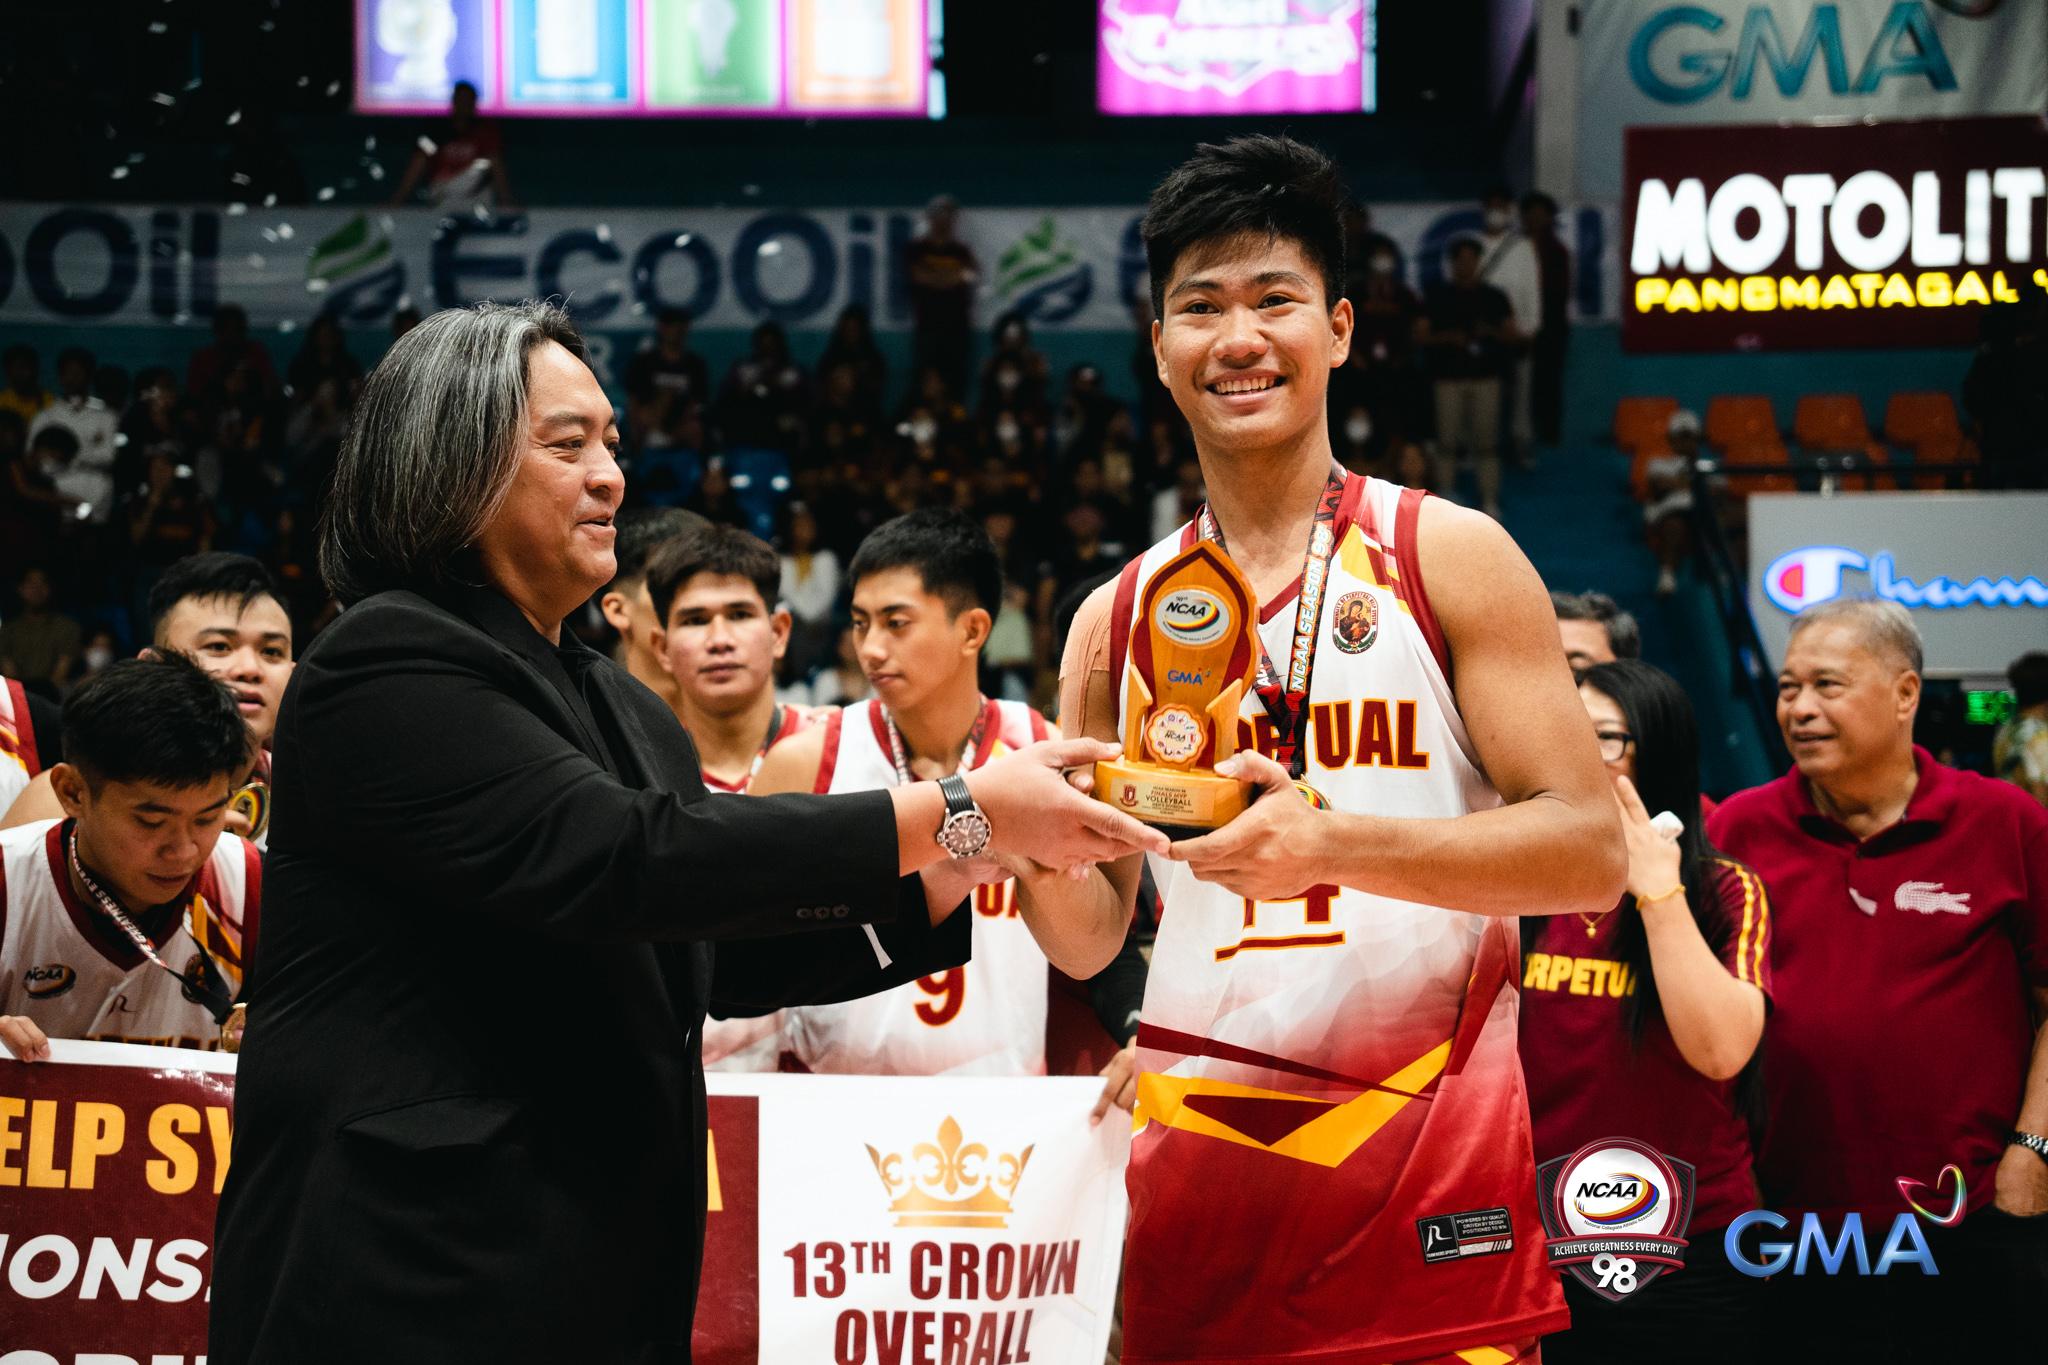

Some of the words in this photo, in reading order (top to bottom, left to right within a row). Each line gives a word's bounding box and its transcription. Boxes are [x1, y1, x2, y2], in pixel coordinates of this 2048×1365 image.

[1627, 0, 1959, 105] GMA
[1631, 167, 2048, 275] MOTOLIT
[0, 208, 220, 318] Oil
[1166, 601, 1207, 617] NCAA
[1299, 557, 1325, 635] SEASON
[1167, 669, 1203, 686] GMA
[1290, 636, 1312, 691] NCAA
[1145, 795, 1192, 806] VOLLEYBALL
[24, 968, 64, 980] NCAA
[1523, 952, 1637, 997] RPETU
[0, 1233, 211, 1303] ONS
[784, 1241, 890, 1298] 13TH
[910, 1240, 1080, 1300] CROWN
[834, 1308, 1034, 1365] OVERALL
